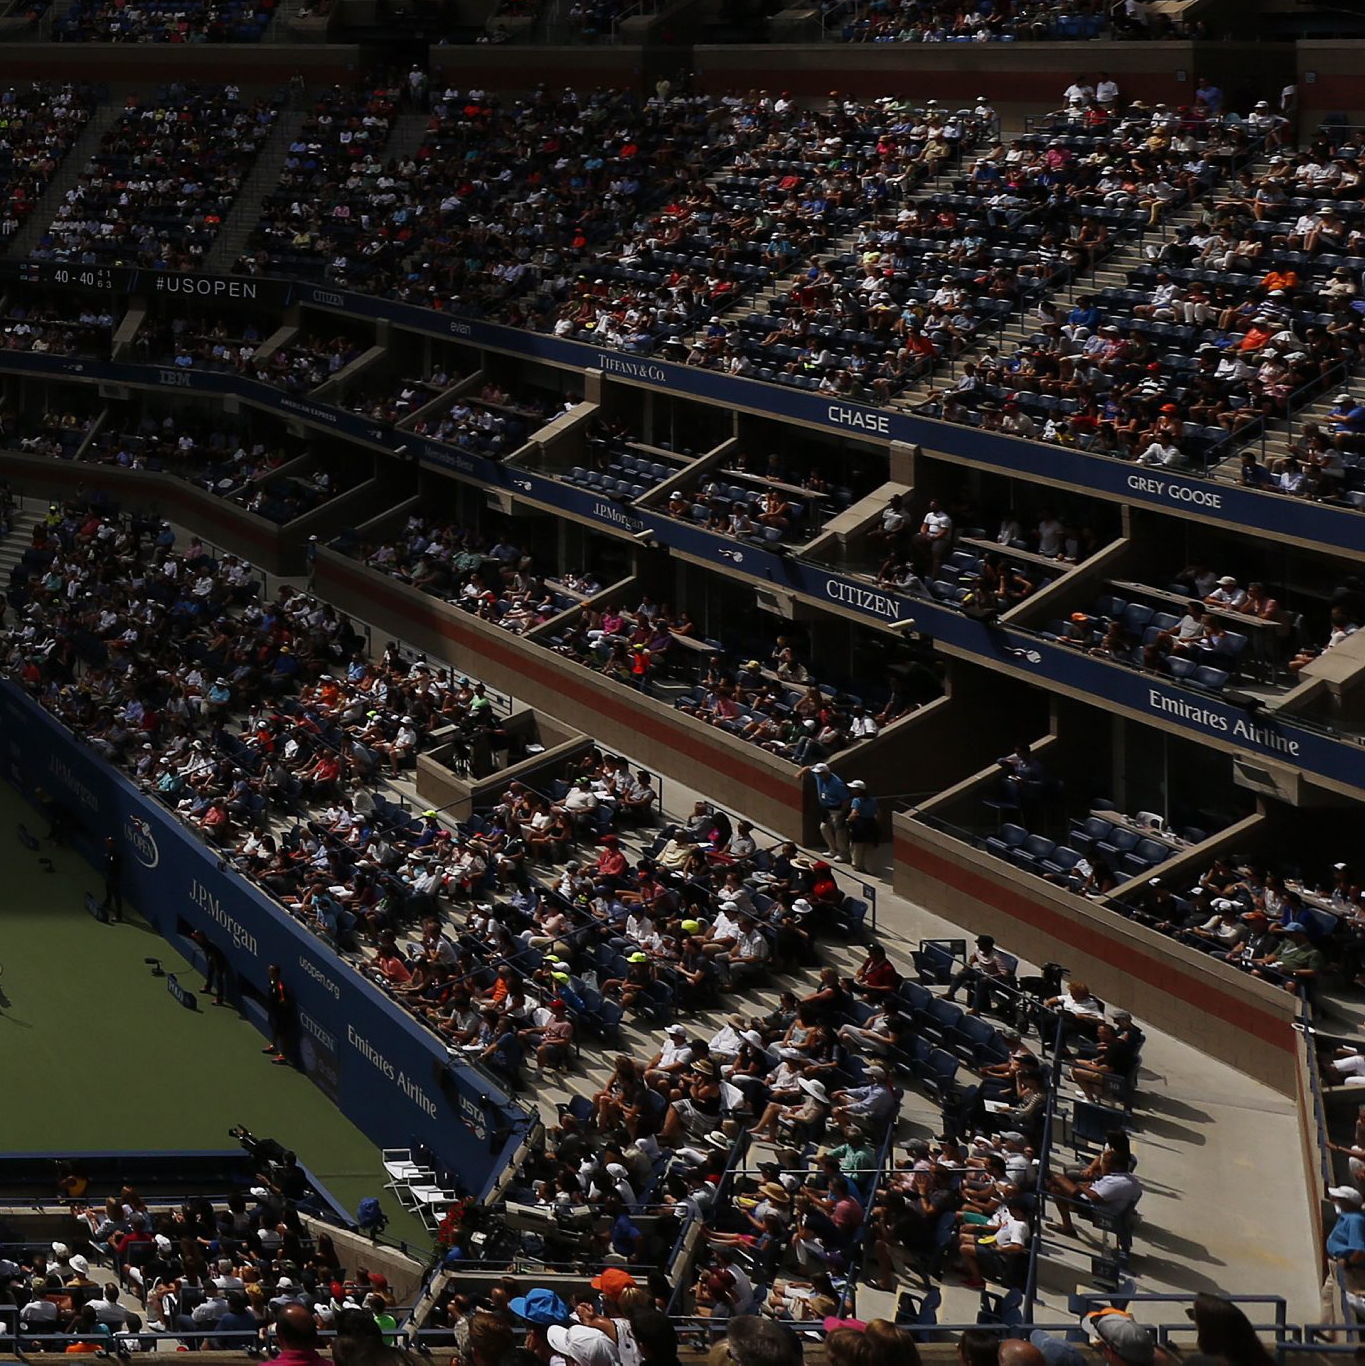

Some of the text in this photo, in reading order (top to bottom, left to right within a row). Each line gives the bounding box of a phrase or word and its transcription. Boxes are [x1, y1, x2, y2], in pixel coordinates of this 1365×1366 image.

[54, 270, 69, 283] 40
[79, 272, 94, 285] 40
[156, 276, 257, 299] #USOPEN
[312, 289, 345, 307] CITIZEN
[449, 321, 471, 335] evian
[159, 371, 192, 386] IBM
[280, 398, 337, 423] AMERICAN EXPRESS
[828, 405, 890, 434] CHASE
[1127, 475, 1222, 509] GREY GOOSE
[593, 502, 644, 532] J.P.Morgan
[826, 579, 900, 619] CITIZEN
[1149, 688, 1300, 757] Emirates Airline
[189, 878, 259, 958] J.P.Morgan
[298, 955, 341, 1001] usopen.org
[299, 1011, 335, 1053] CITIZEN
[347, 1023, 395, 1081] Emirates
[397, 1070, 438, 1121] Airline
[458, 1094, 486, 1128] USTA
